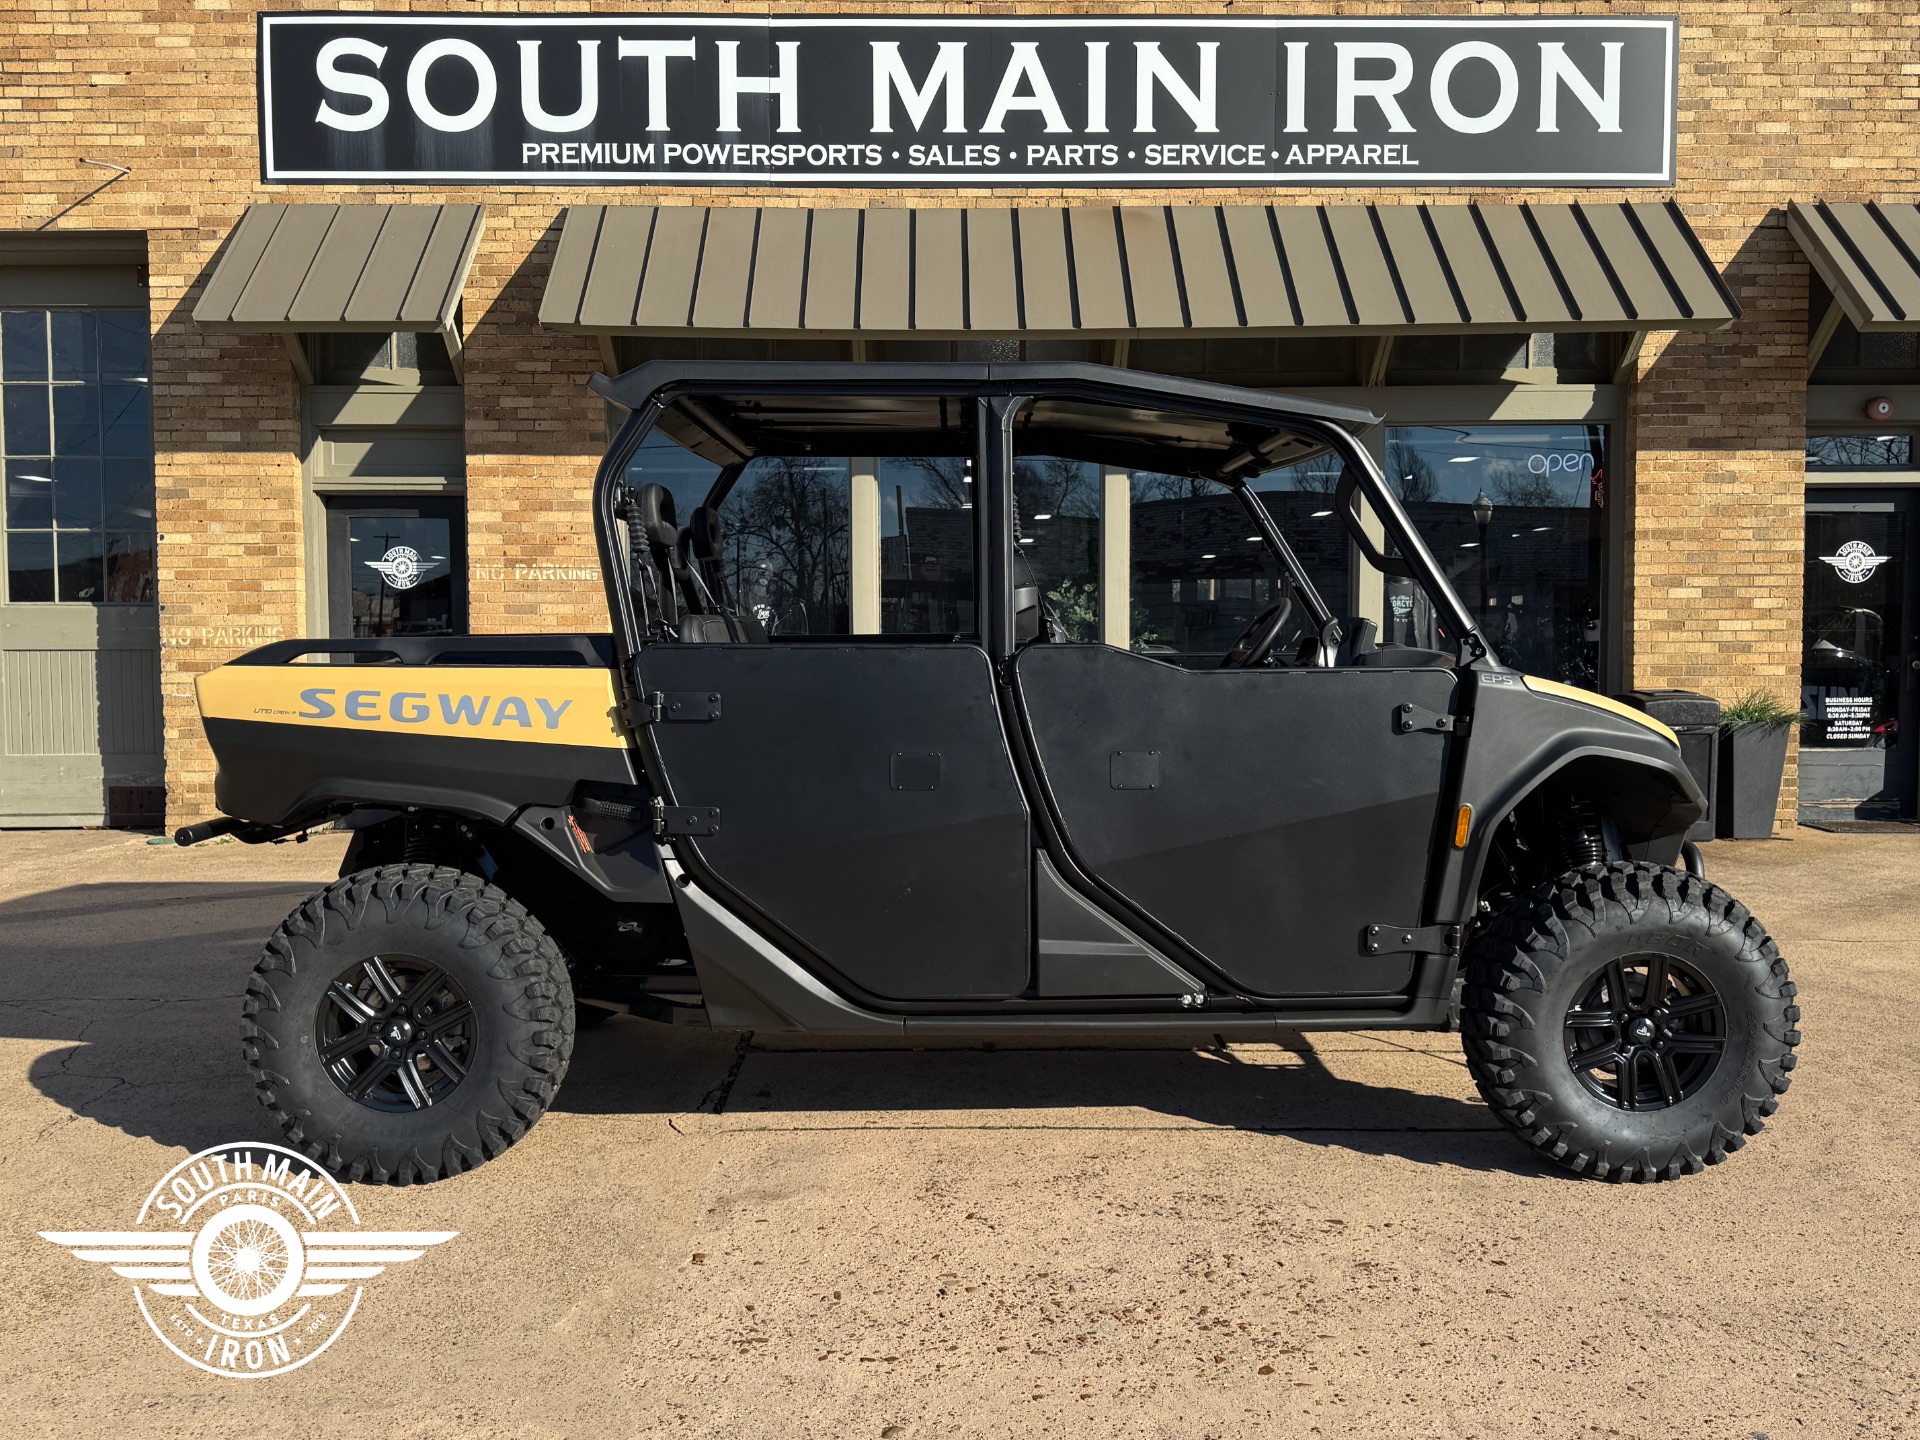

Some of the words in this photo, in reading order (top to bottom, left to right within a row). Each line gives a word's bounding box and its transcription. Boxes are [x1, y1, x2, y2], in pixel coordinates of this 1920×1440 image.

[315, 37, 801, 132] SOUTH
[870, 42, 1220, 133] MAIN
[1283, 41, 1624, 134] IRON
[522, 143, 655, 165] PREMIUM
[664, 144, 882, 166] POWERSPORTS
[909, 145, 1000, 167] SALES
[1027, 144, 1118, 166] PARTS
[1144, 144, 1265, 166] SERVICE
[1285, 144, 1419, 166] APPAREL
[1528, 453, 1594, 478] open
[385, 548, 403, 561] SOUTH
[405, 548, 419, 561] MAIN
[475, 563, 504, 580] NO
[515, 563, 599, 580] PARKING
[202, 626, 284, 645] PARKING
[1481, 673, 1513, 685] EPS
[299, 688, 573, 729] SEGWAY
